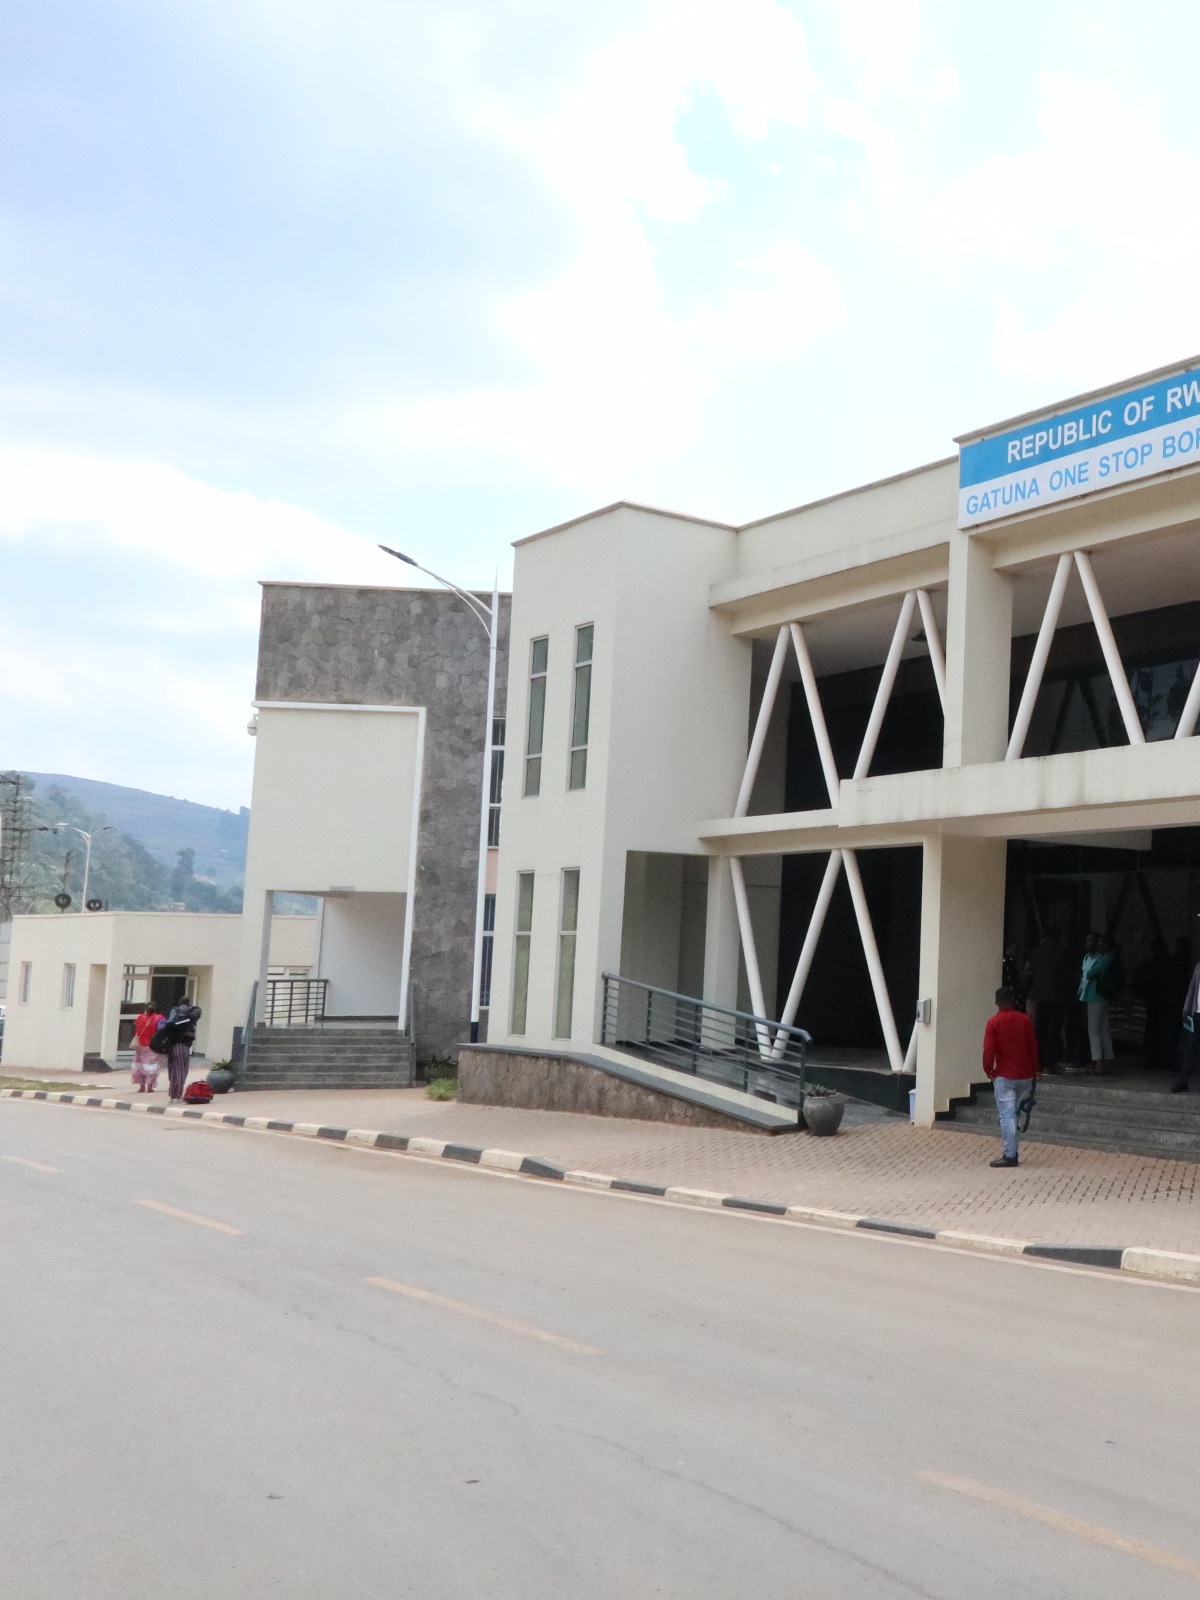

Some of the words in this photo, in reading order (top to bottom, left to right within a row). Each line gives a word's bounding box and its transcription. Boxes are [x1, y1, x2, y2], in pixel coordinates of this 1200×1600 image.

[1007, 410, 1112, 464] REPUBLIC
[1123, 396, 1155, 427] OF
[966, 476, 1040, 515] GATUNA
[1049, 461, 1089, 491] ONE
[1098, 442, 1153, 477] STOP
